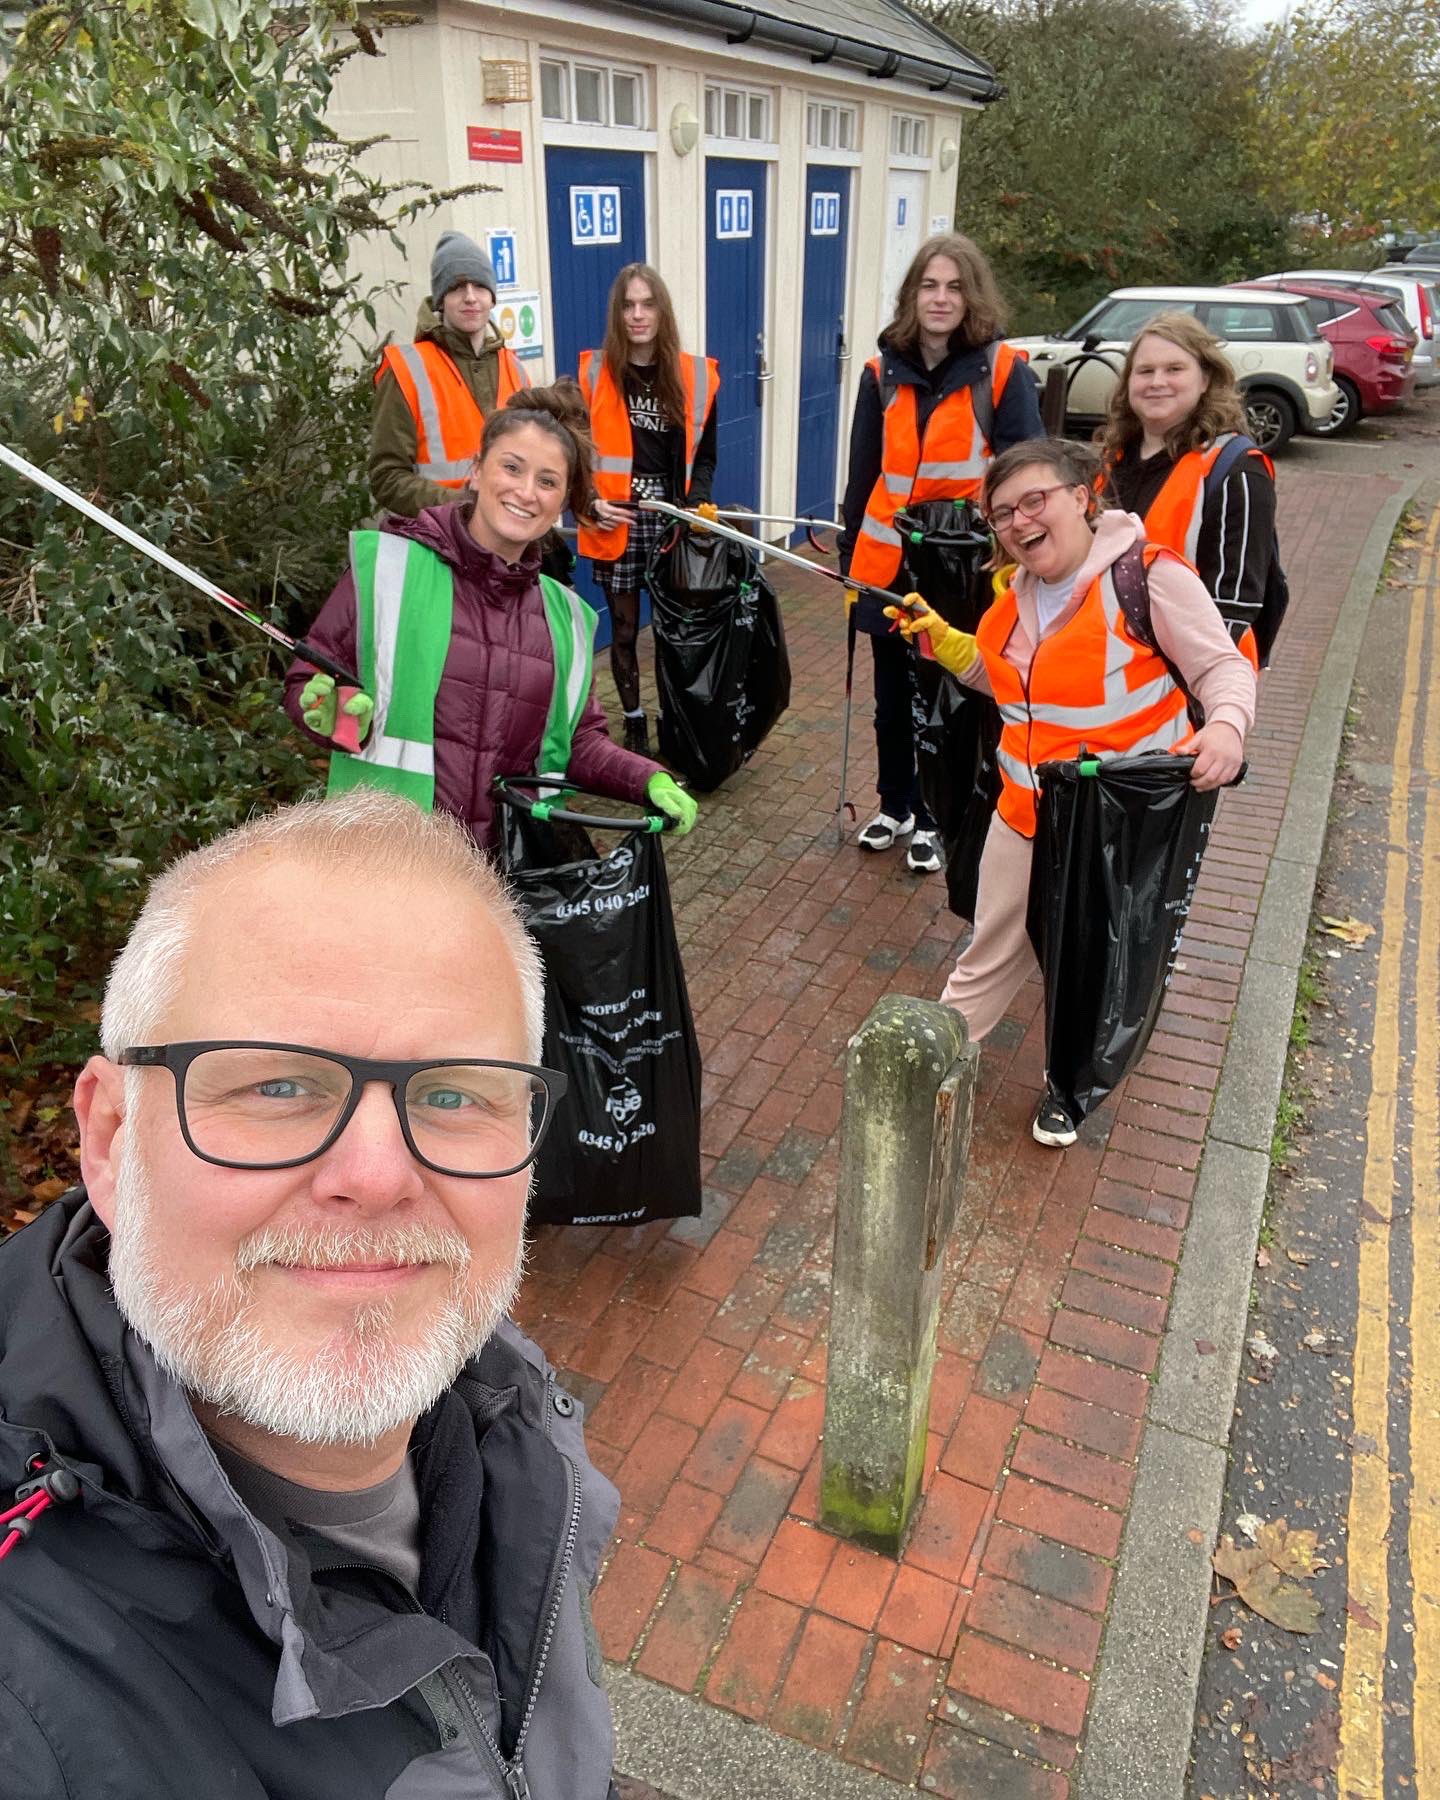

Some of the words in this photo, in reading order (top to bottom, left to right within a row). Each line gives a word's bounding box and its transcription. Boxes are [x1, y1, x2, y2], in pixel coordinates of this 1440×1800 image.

[556, 900, 591, 919] 0345
[594, 895, 623, 913] 040
[578, 1129, 613, 1150] 0345
